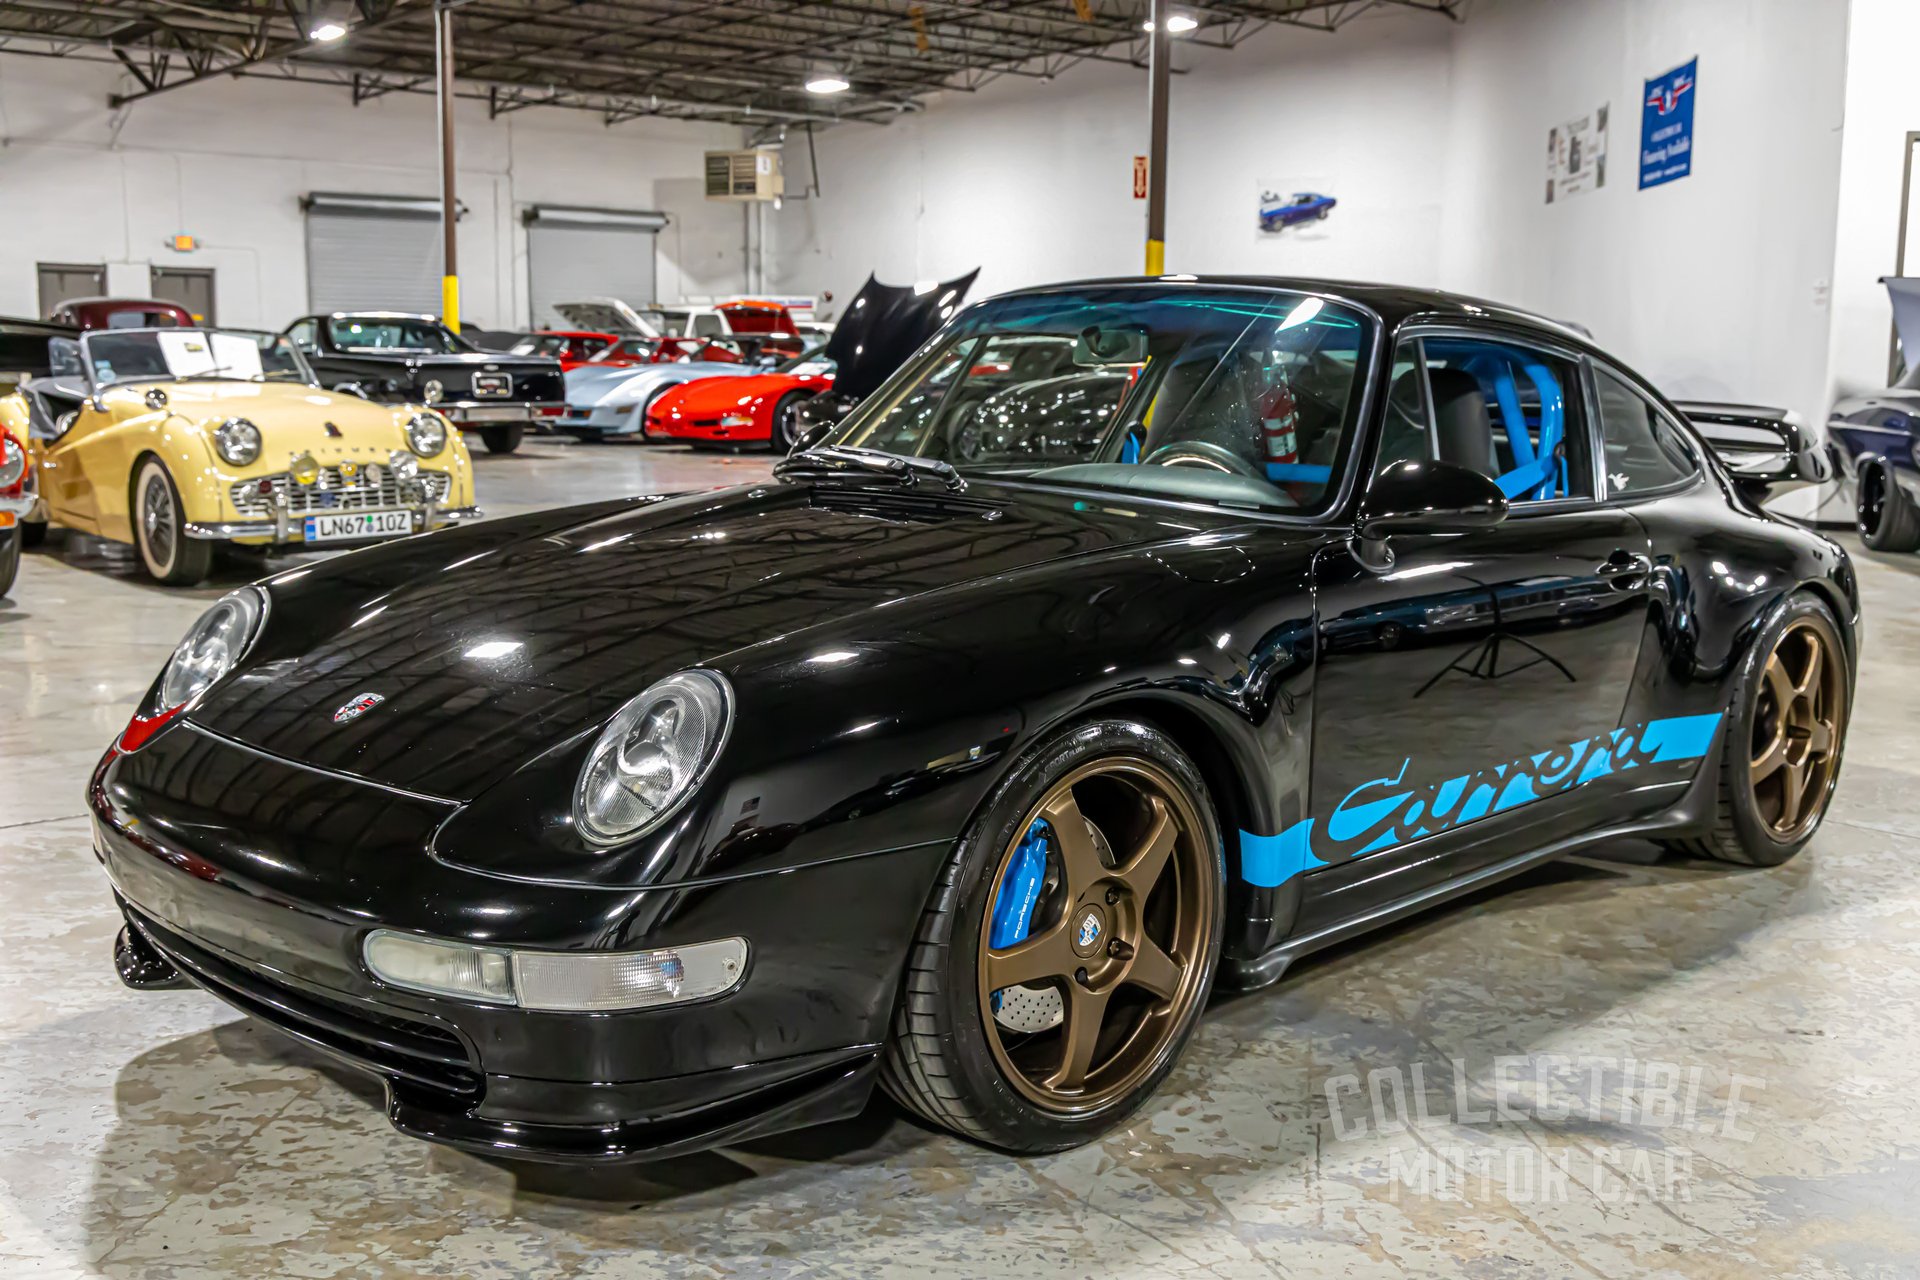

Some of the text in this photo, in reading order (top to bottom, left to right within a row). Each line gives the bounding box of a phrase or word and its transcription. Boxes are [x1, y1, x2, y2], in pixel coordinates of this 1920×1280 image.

[320, 516, 365, 537] LN67
[1309, 725, 1661, 863] Carrera
[1014, 877, 1036, 939] PORSCHE
